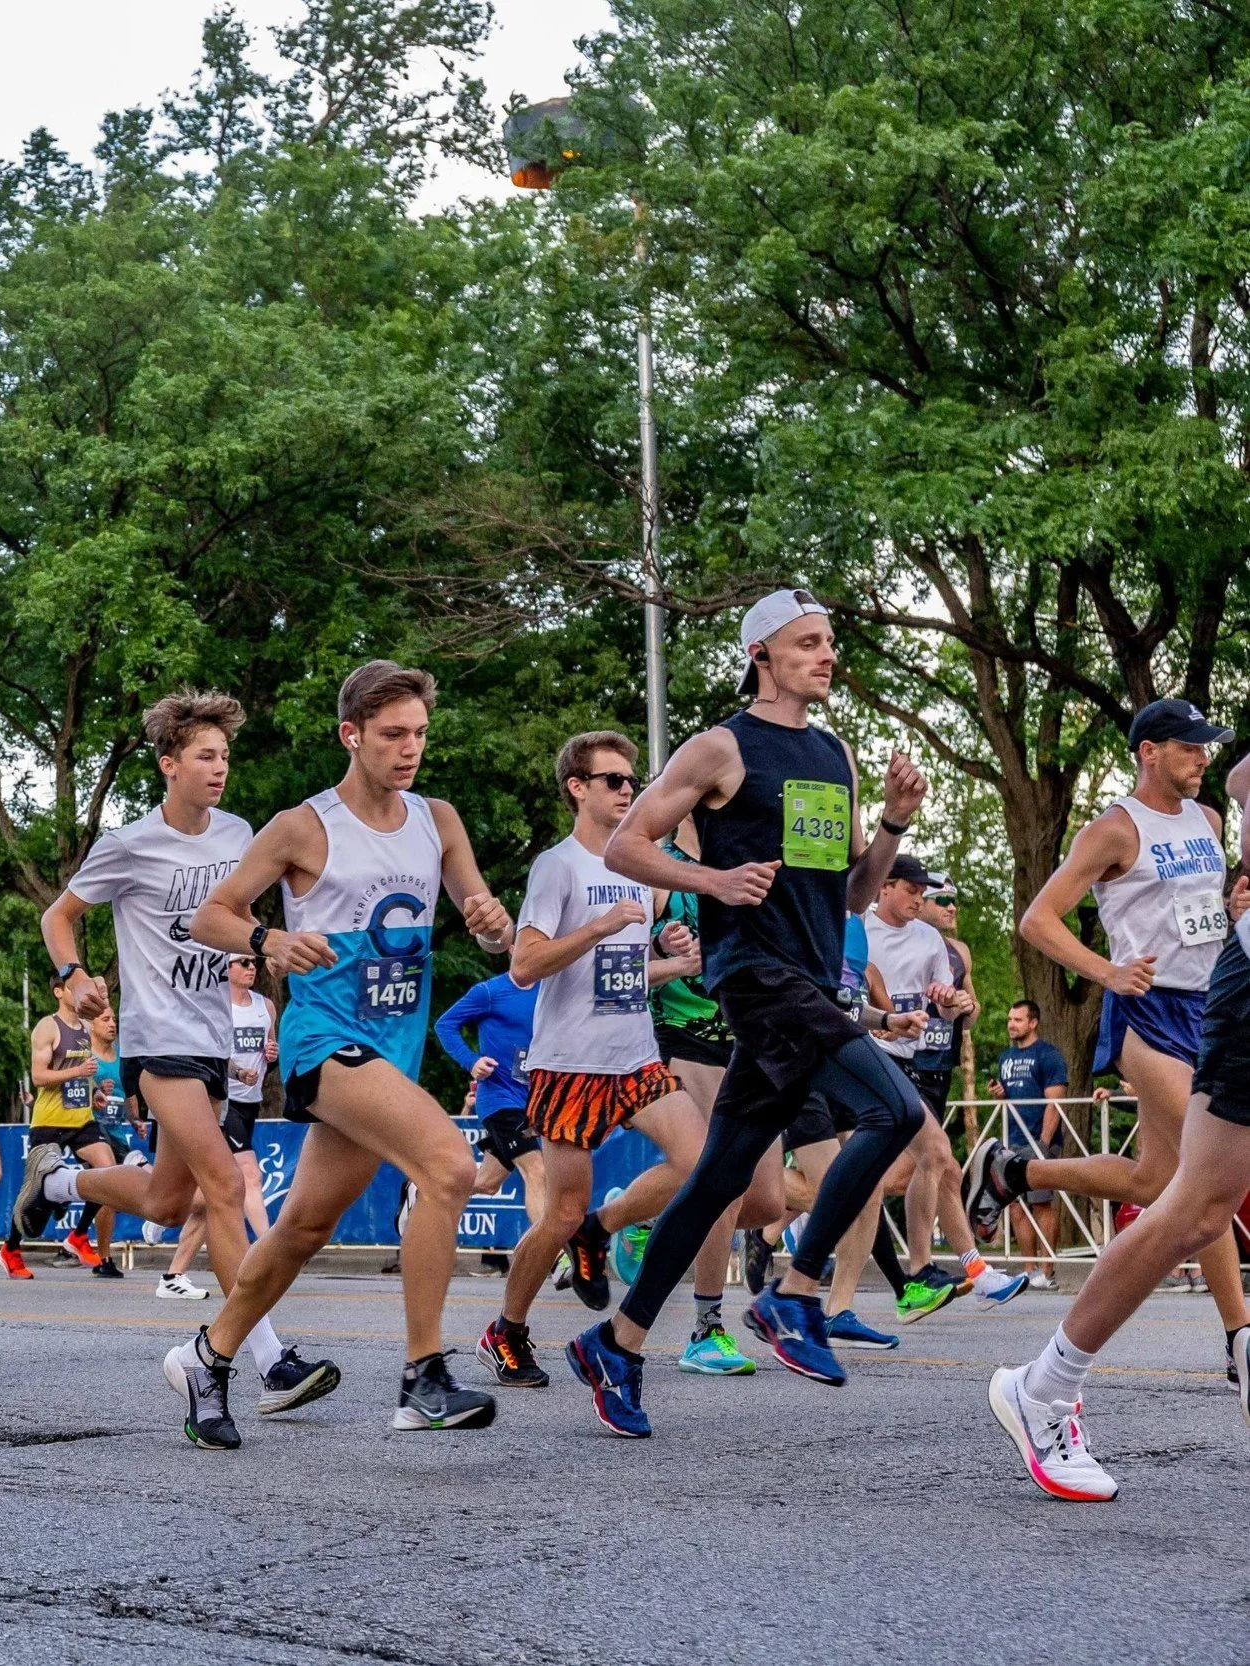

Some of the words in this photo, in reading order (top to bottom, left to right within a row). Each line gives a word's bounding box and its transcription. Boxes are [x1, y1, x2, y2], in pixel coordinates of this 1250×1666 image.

[791, 816, 845, 841] 4383
[1151, 842, 1184, 865] ST.
[1183, 838, 1220, 860] JUDE
[1156, 858, 1203, 881] RUNNING
[165, 860, 240, 912] NIK
[380, 874, 427, 890] CHICAGO
[587, 885, 643, 906] TIMBERLINE
[171, 951, 229, 992] NIKE
[600, 971, 643, 991] 1394
[366, 980, 417, 1007] 1476
[237, 1037, 263, 1048] 1097
[926, 1031, 950, 1044] 098
[67, 1087, 86, 1098] 803
[106, 1105, 119, 1115] 57
